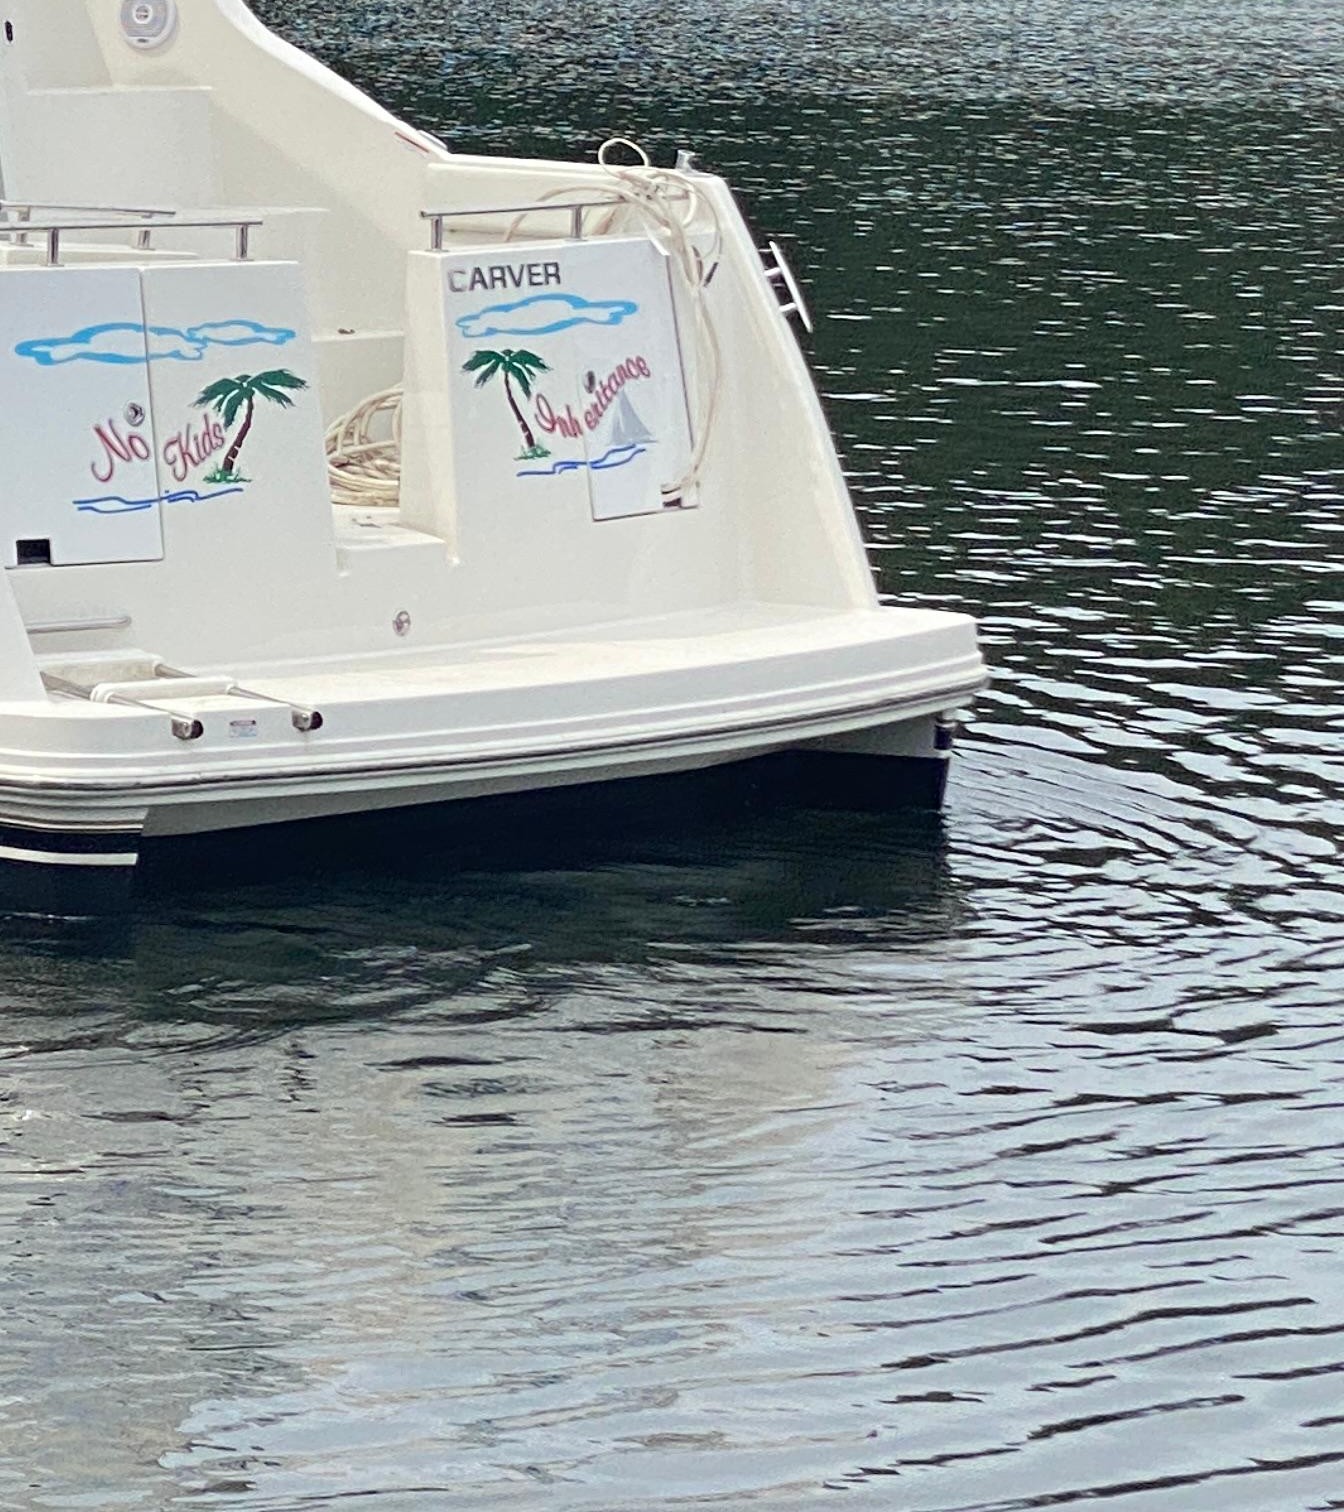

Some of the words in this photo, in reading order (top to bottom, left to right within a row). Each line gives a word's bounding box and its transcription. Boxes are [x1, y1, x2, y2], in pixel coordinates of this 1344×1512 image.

[448, 262, 561, 293] CARVER
[534, 355, 651, 438] Inheritance
[91, 418, 150, 482] No
[163, 413, 225, 482] Kids
